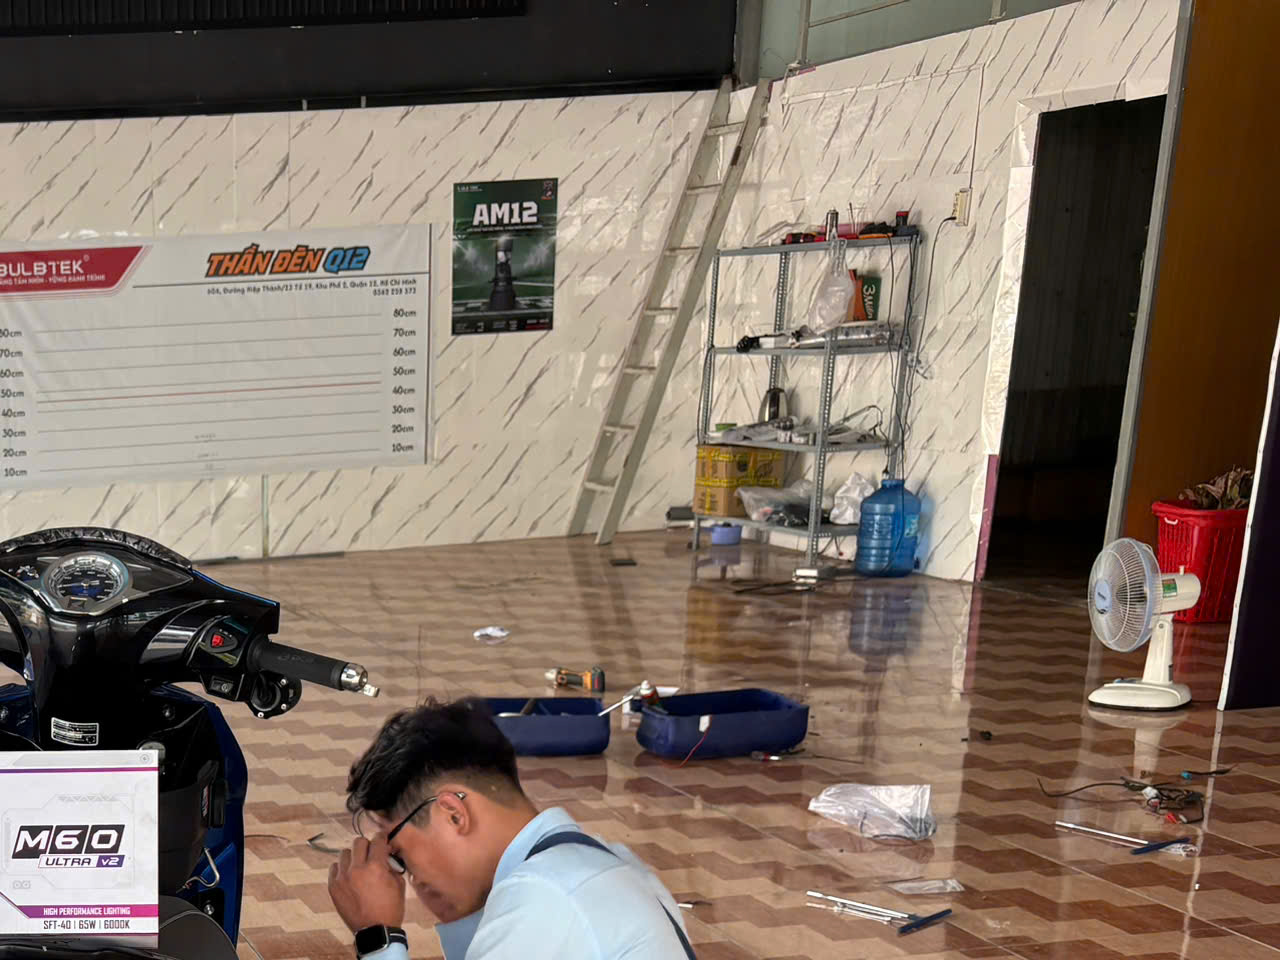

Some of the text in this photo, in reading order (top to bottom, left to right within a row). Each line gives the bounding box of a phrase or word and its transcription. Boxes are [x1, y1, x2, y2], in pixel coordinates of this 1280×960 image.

[472, 201, 538, 226] AM12
[322, 246, 371, 275] Q12
[393, 328, 417, 337] 70cm
[0, 348, 23, 358] 70cm
[393, 347, 416, 357] 60cm
[0, 369, 24, 379] 60cm
[392, 366, 416, 376] 50cm
[0, 389, 25, 398] 50cm
[392, 385, 416, 395] 40cm
[1, 408, 26, 418] 40cm
[392, 404, 415, 414] 30cm
[2, 428, 27, 438] 30cm
[391, 423, 414, 433] 20cm
[2, 448, 27, 458] 20cm
[391, 443, 414, 453] 10cm
[4, 467, 28, 477] 10cm
[14, 828, 119, 854] M60
[45, 857, 92, 866] ULTRA
[43, 907, 131, 916] HIGH PERFORMANCE LIGHTING
[43, 919, 130, 930] SFT-40 65W 6000K
